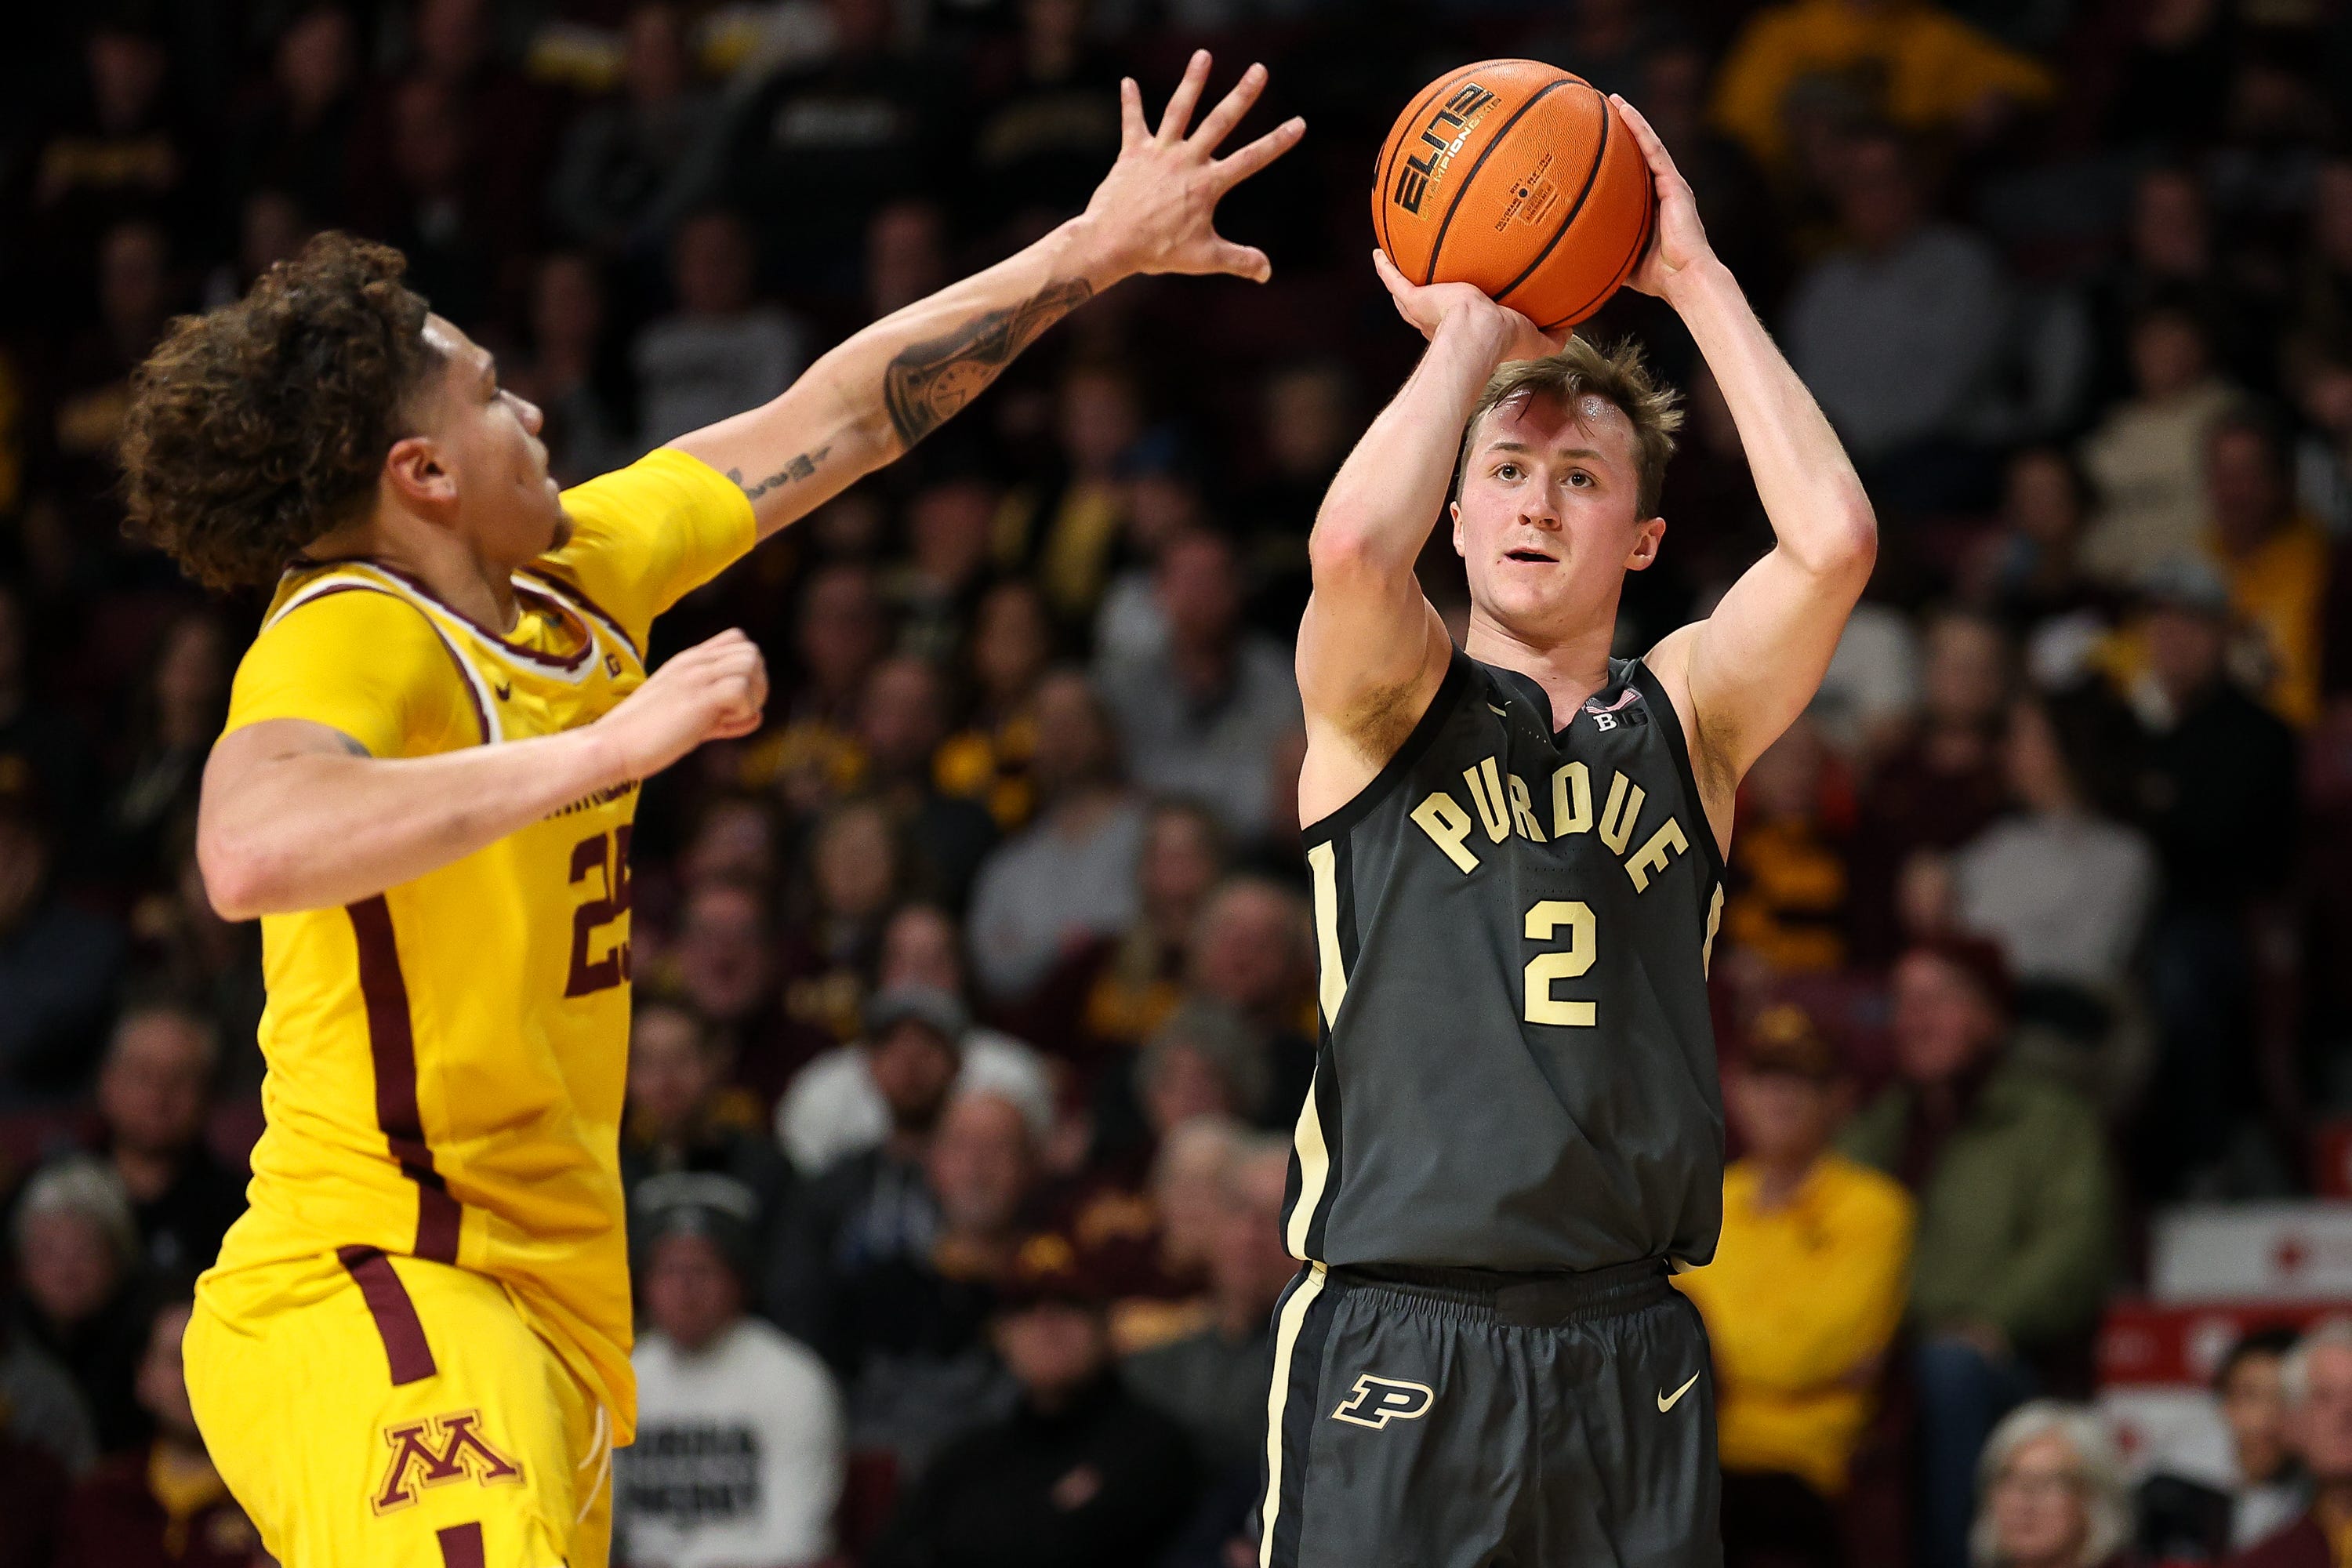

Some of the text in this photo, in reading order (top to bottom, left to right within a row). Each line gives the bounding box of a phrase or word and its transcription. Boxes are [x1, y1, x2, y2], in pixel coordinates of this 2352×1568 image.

[1394, 82, 1495, 216] ELITE
[1410, 755, 1690, 895] PURDUE
[1524, 900, 1597, 1026] 2
[370, 1409, 527, 1518] M
[1330, 1374, 1435, 1430] P
